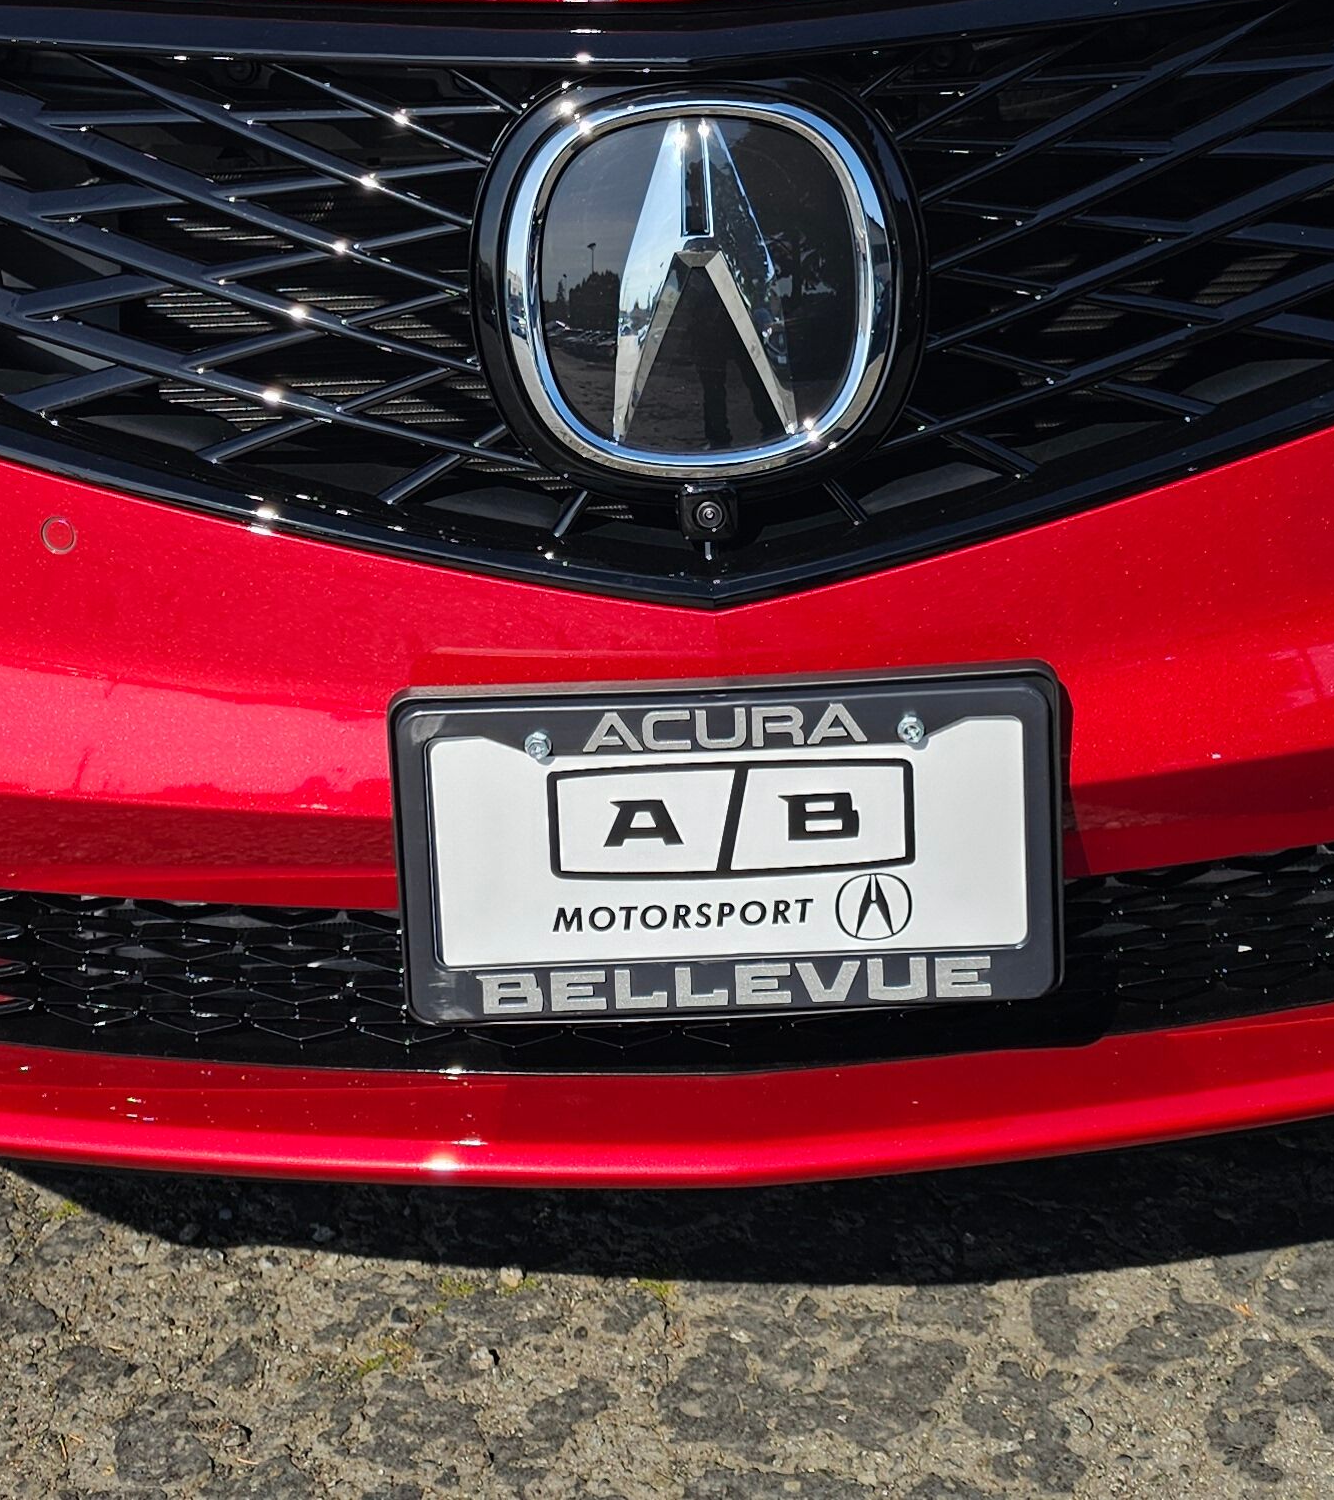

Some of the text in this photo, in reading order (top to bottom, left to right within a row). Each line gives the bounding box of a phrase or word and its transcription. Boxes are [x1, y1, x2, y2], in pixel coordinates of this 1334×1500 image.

[582, 702, 868, 754] ACURA
[603, 790, 861, 848] A B
[551, 897, 815, 933] MOTORSPORT
[475, 955, 993, 1015] BELLEVUE
